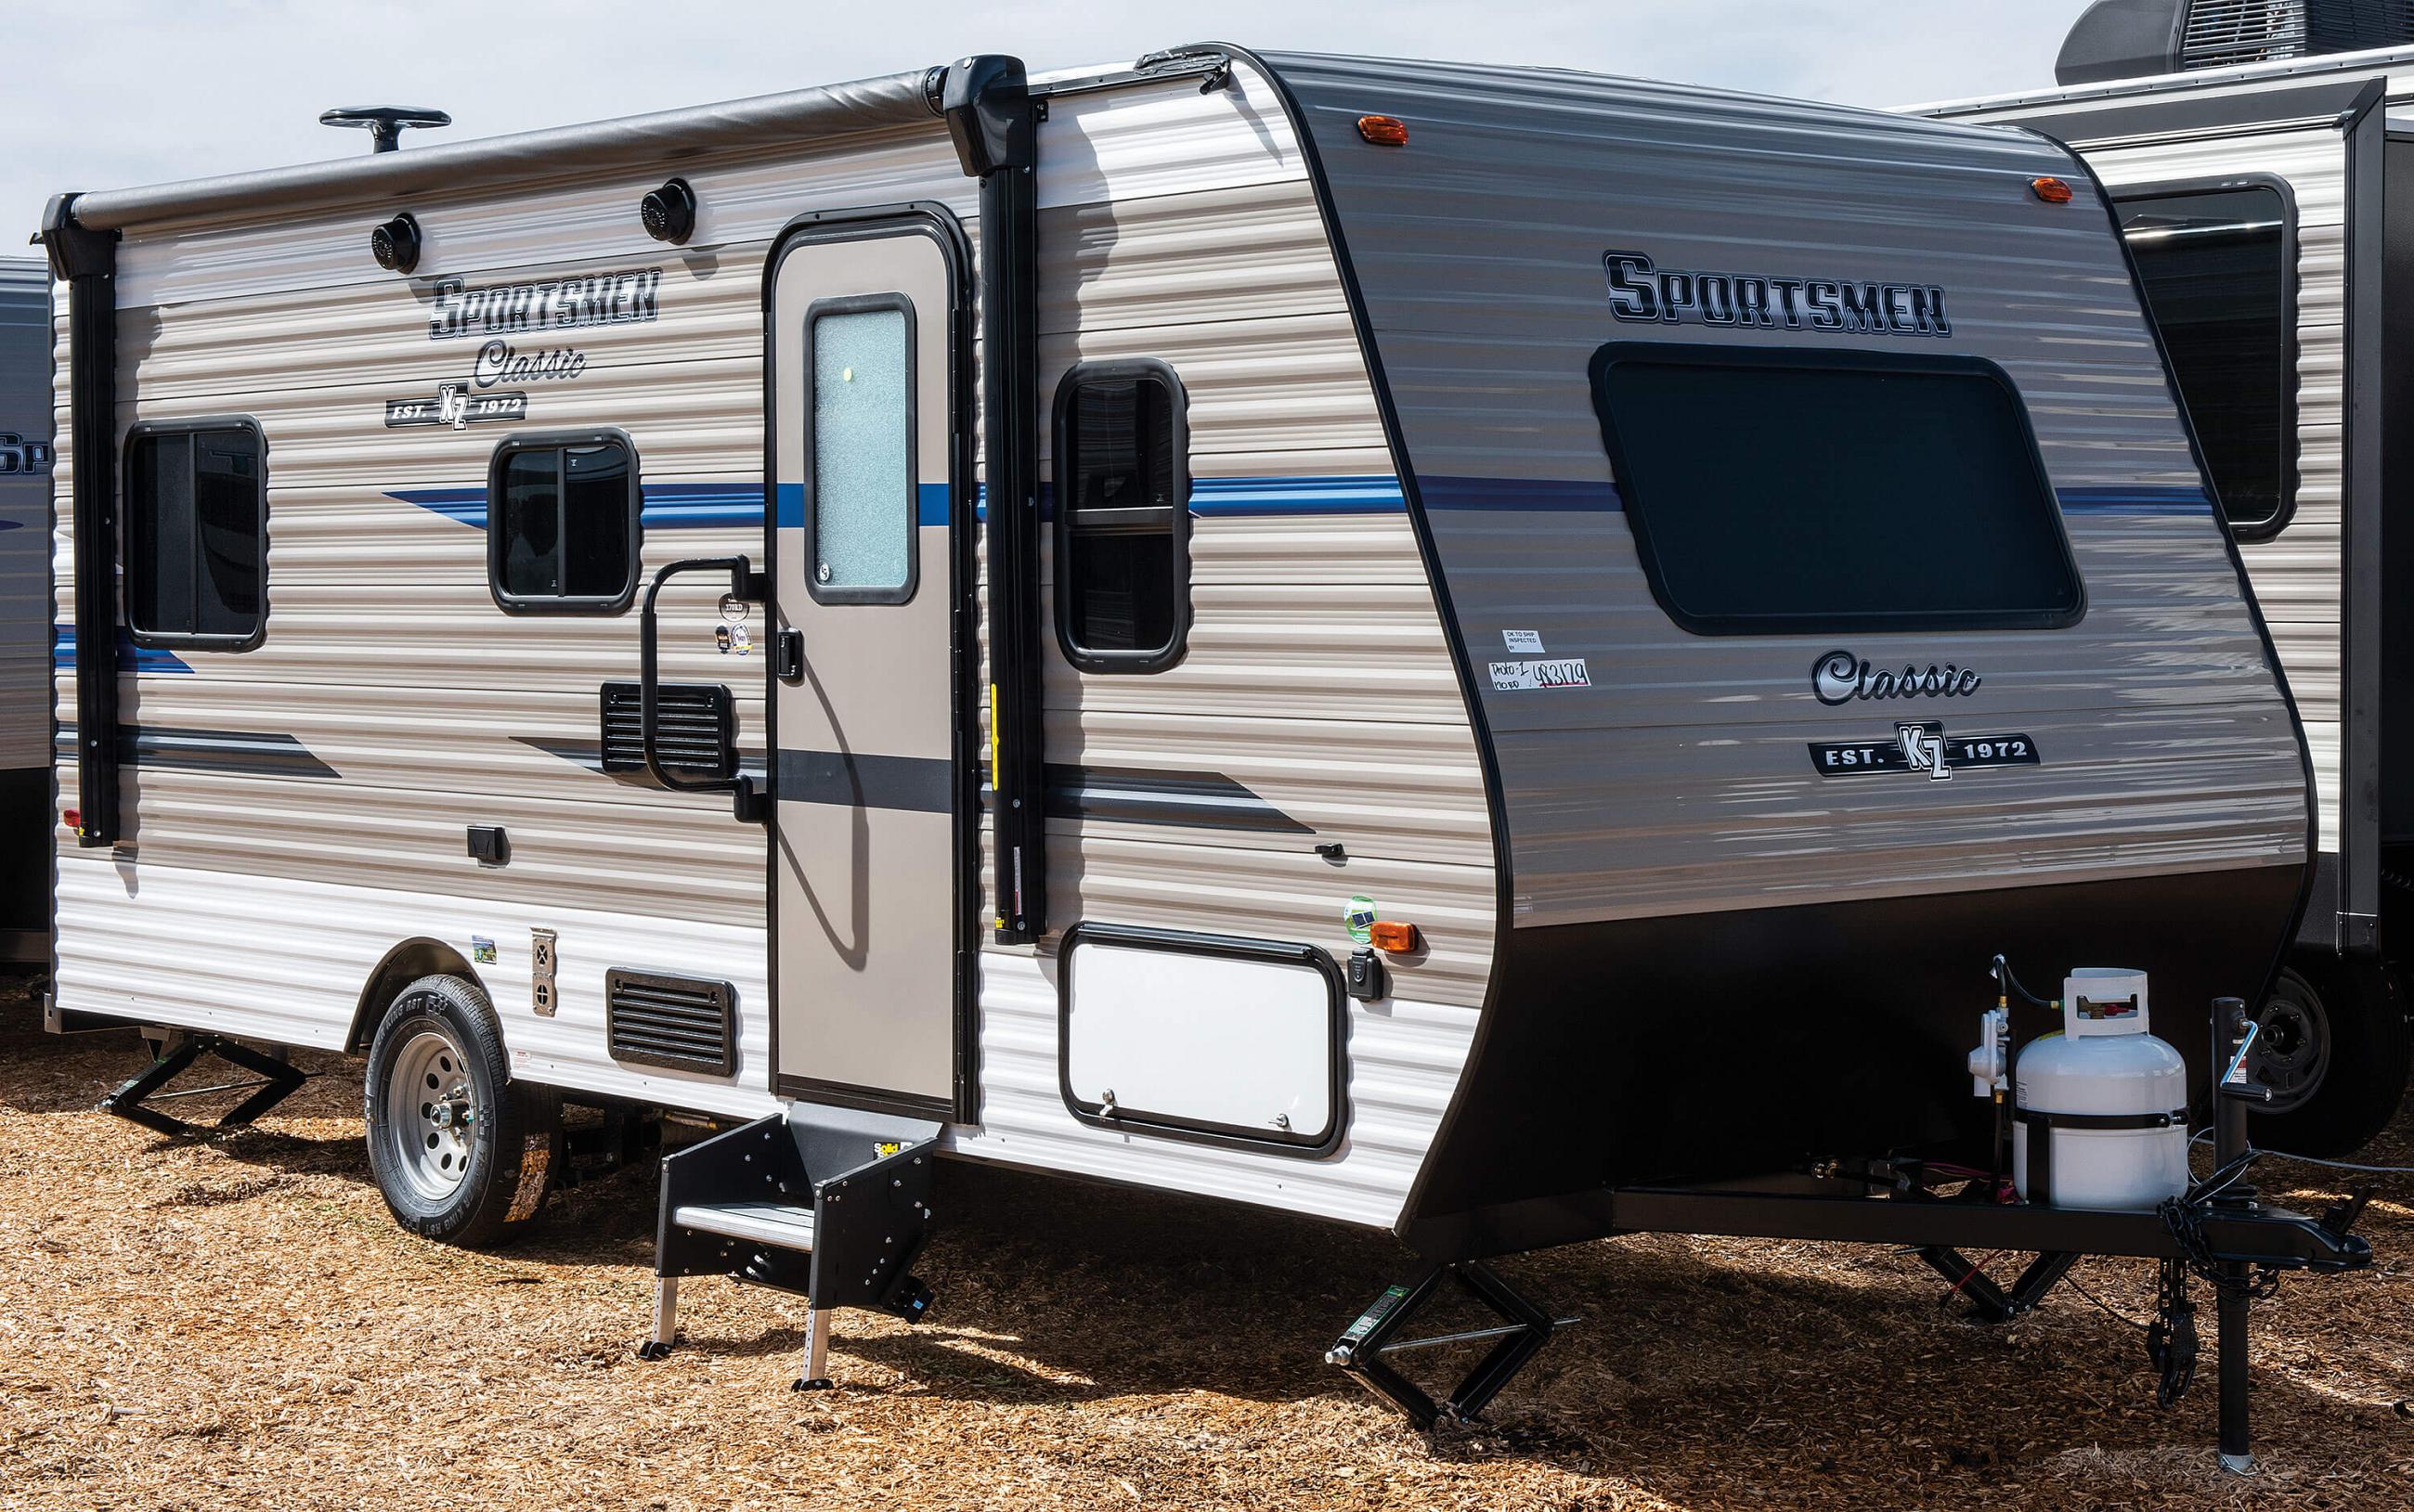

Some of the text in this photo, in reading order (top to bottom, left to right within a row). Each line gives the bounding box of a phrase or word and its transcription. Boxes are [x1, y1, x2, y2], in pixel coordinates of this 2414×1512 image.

[429, 266, 663, 341] SPORTSMEN
[1602, 250, 1952, 339] SPORTSMEN
[474, 339, 586, 388] Classic
[392, 405, 427, 420] EST.
[478, 398, 522, 415] 1972
[1810, 650, 1982, 706] Classic
[1824, 725, 2029, 782] EST. KZ 1972
[874, 1143, 899, 1153] Solid
